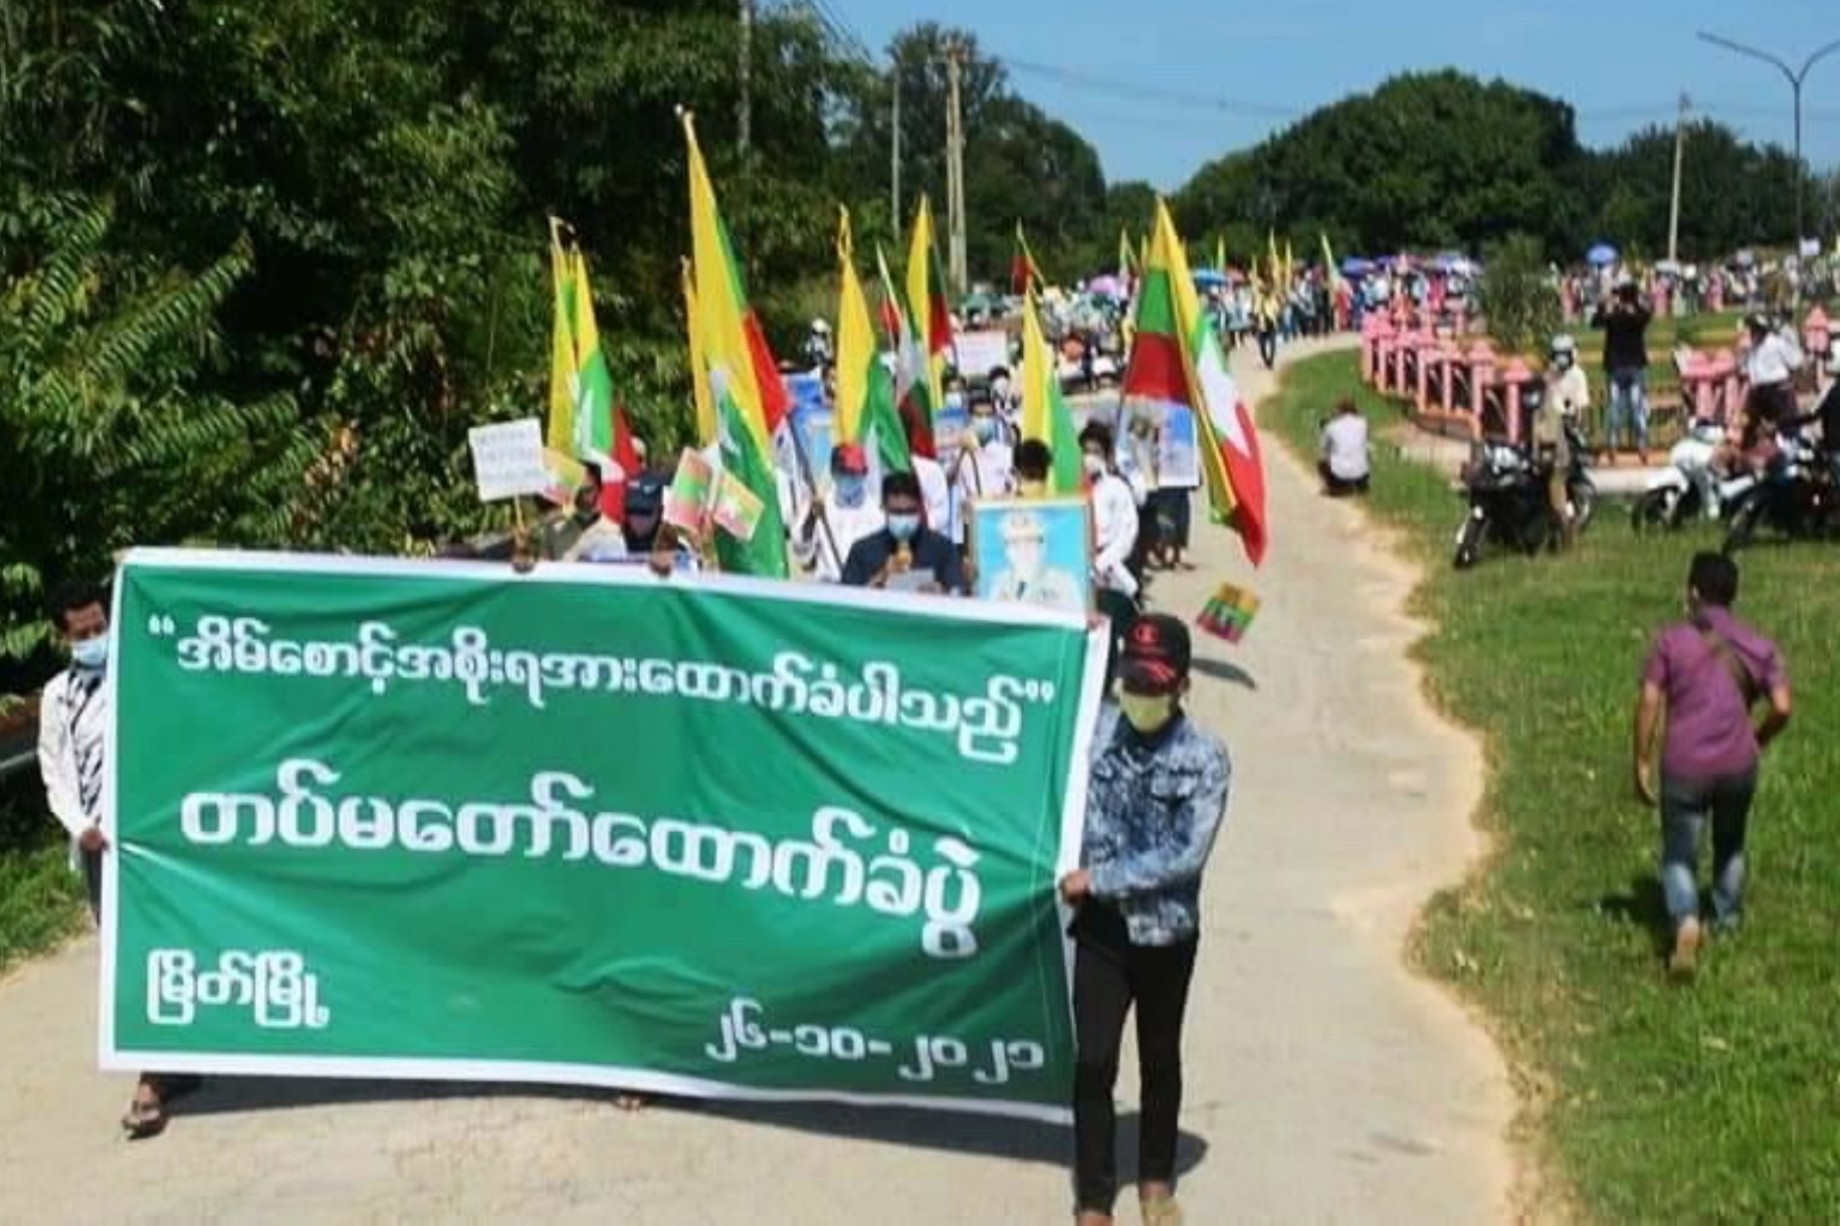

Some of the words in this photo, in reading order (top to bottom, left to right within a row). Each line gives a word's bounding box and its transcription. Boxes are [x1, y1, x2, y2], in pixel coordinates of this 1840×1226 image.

[180, 758, 981, 958] တပ်မတော်ထောက်ခံပွဲ
